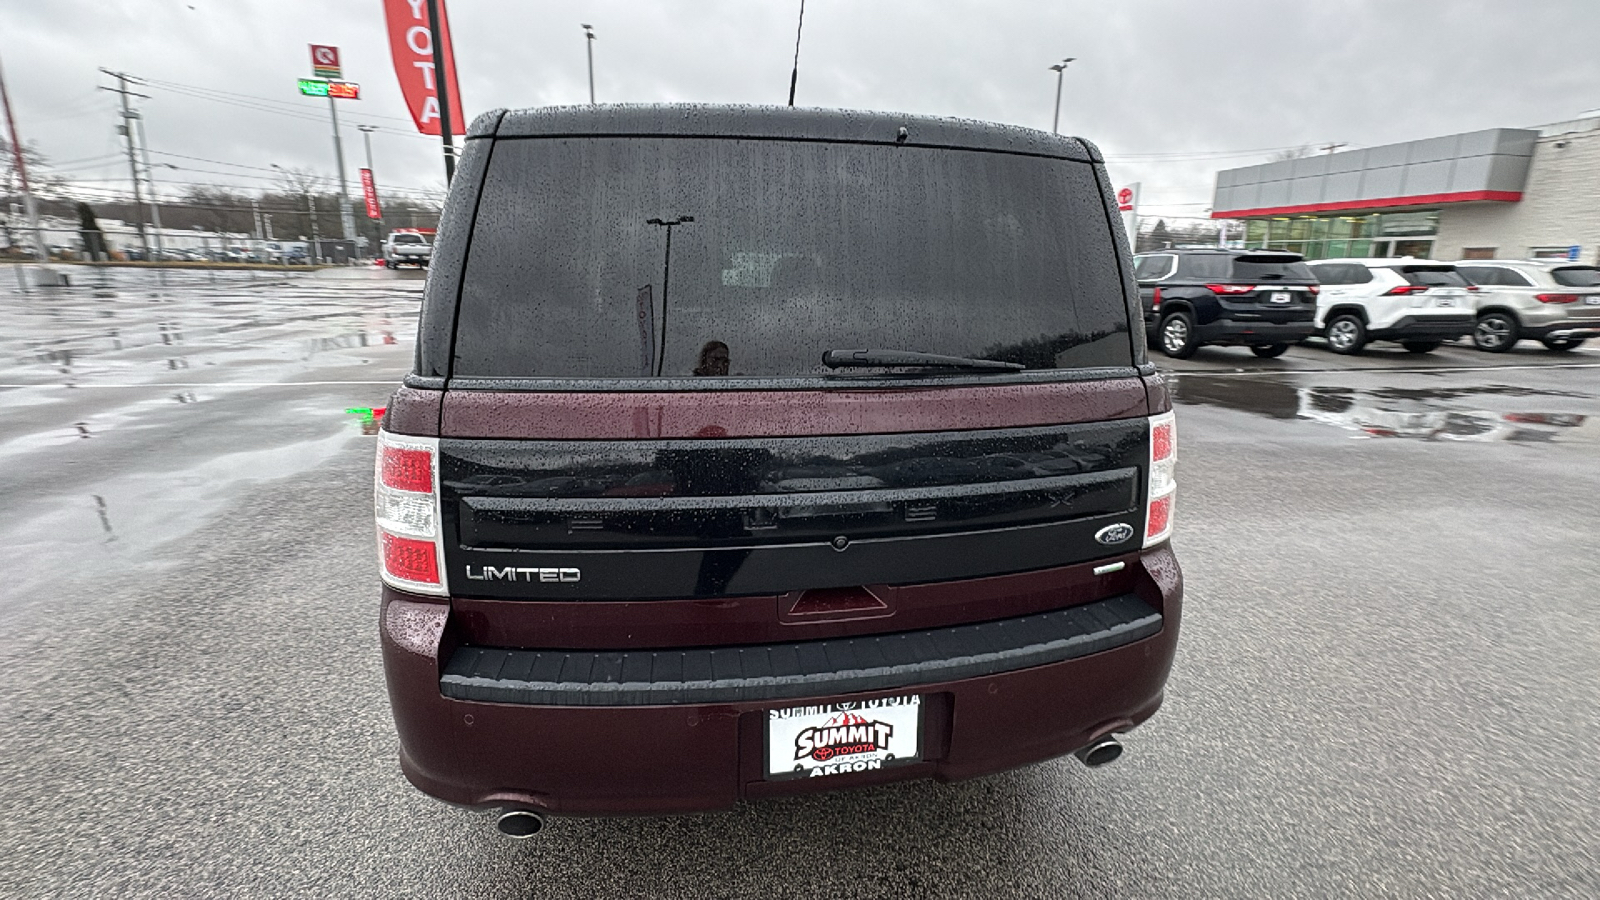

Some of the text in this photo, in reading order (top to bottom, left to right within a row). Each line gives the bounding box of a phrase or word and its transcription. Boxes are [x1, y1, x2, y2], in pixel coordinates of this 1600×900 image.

[466, 564, 581, 583] LIMITED
[795, 721, 892, 759] SUMMIT
[834, 743, 876, 756] TOYOTA
[809, 758, 881, 778] AKRON
